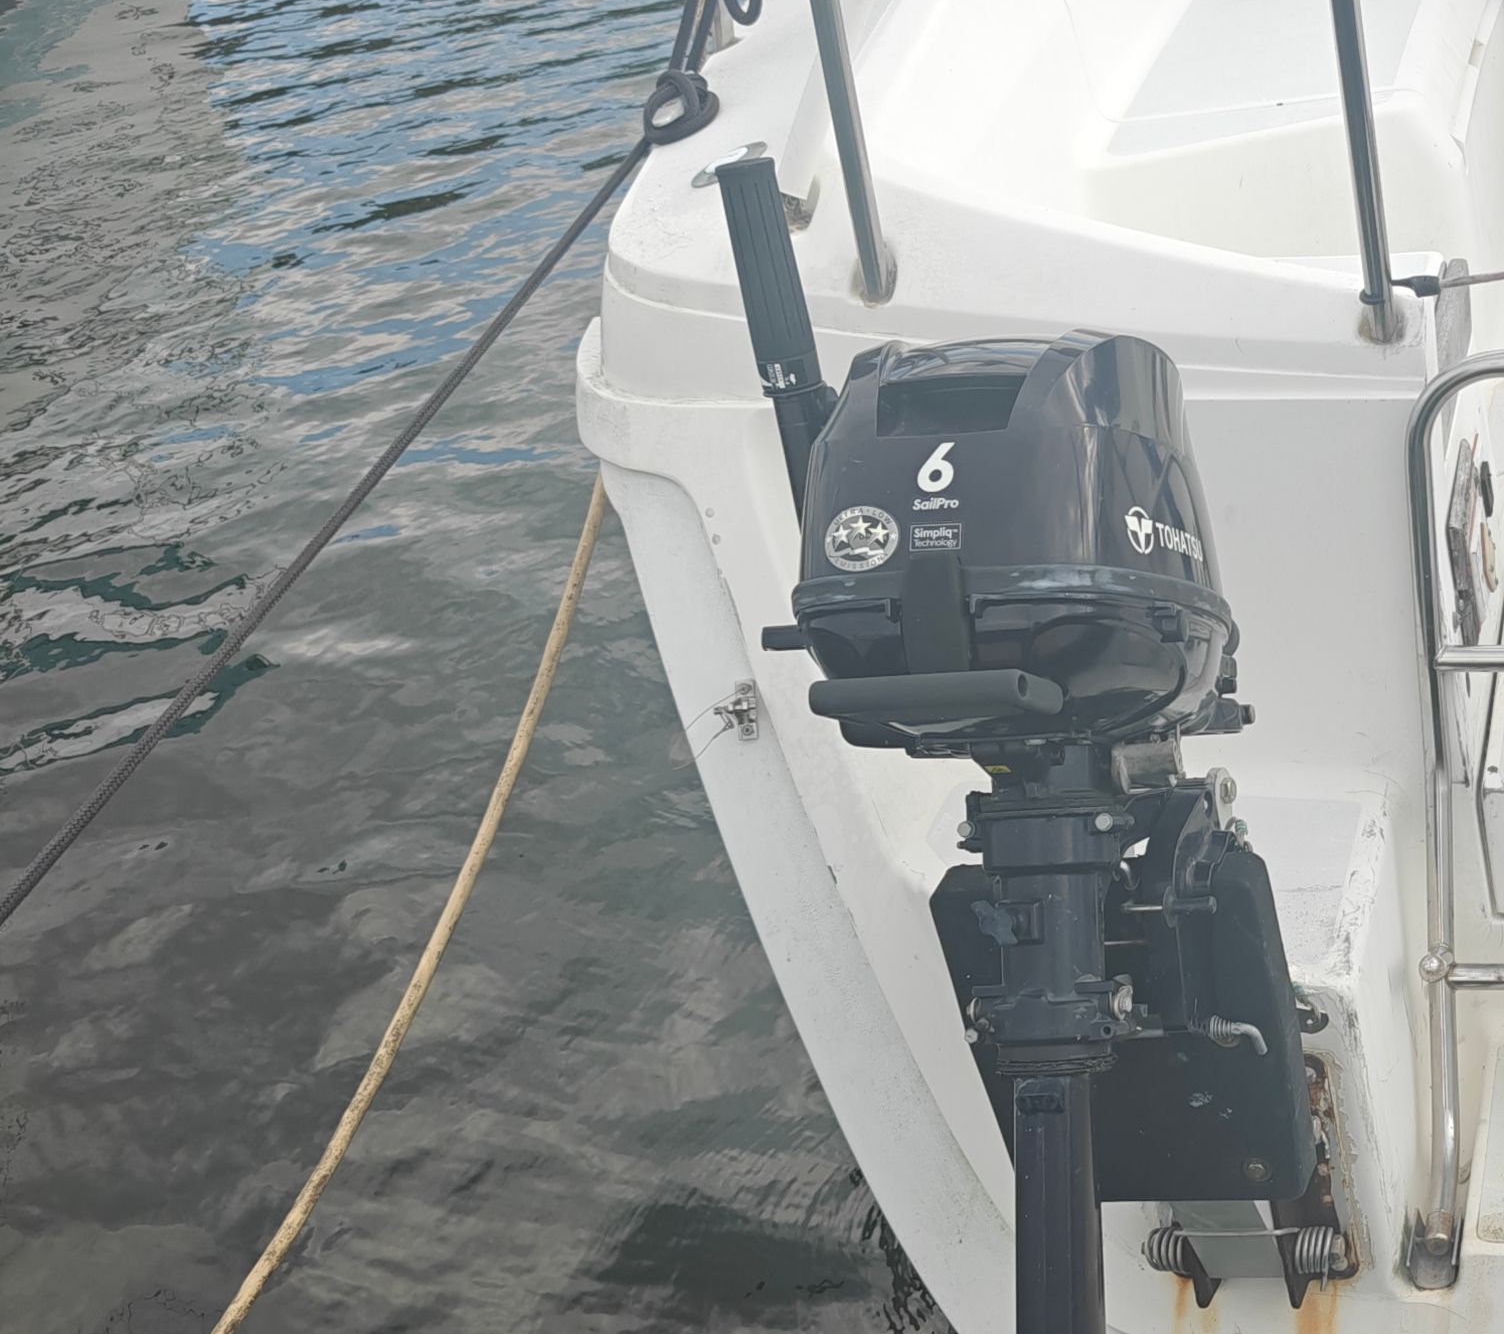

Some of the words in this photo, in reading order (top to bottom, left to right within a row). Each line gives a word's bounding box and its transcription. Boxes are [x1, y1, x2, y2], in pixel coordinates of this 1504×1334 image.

[917, 442, 955, 493] 6
[912, 497, 959, 511] SailPro
[871, 509, 893, 525] LOW
[914, 539, 957, 548] Technology
[1155, 522, 1204, 562] TOHATSU
